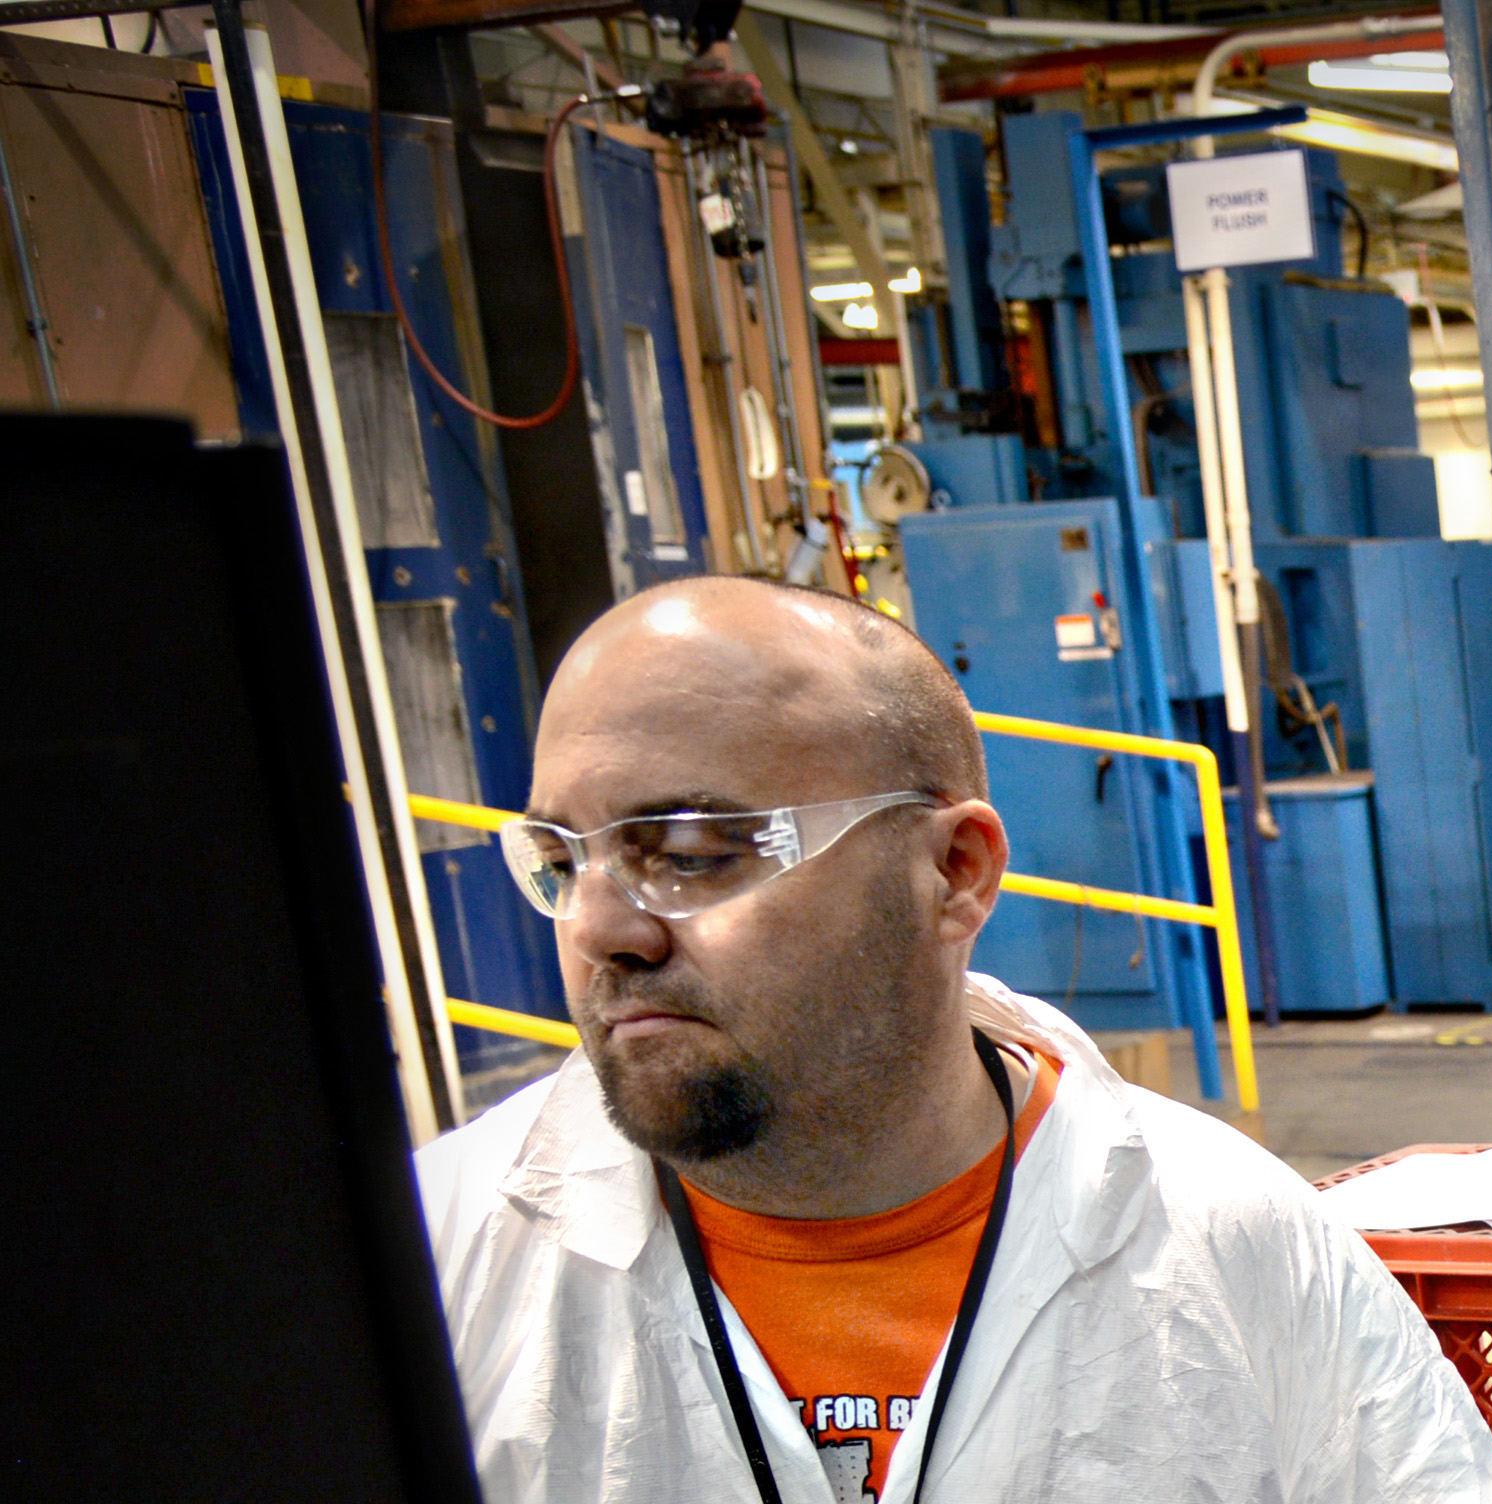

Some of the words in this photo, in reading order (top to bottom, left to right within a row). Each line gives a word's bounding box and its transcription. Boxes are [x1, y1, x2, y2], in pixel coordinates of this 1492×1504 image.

[1206, 189, 1268, 209] POWER
[1212, 212, 1268, 232] FLUSH
[815, 1394, 880, 1431] FOR
